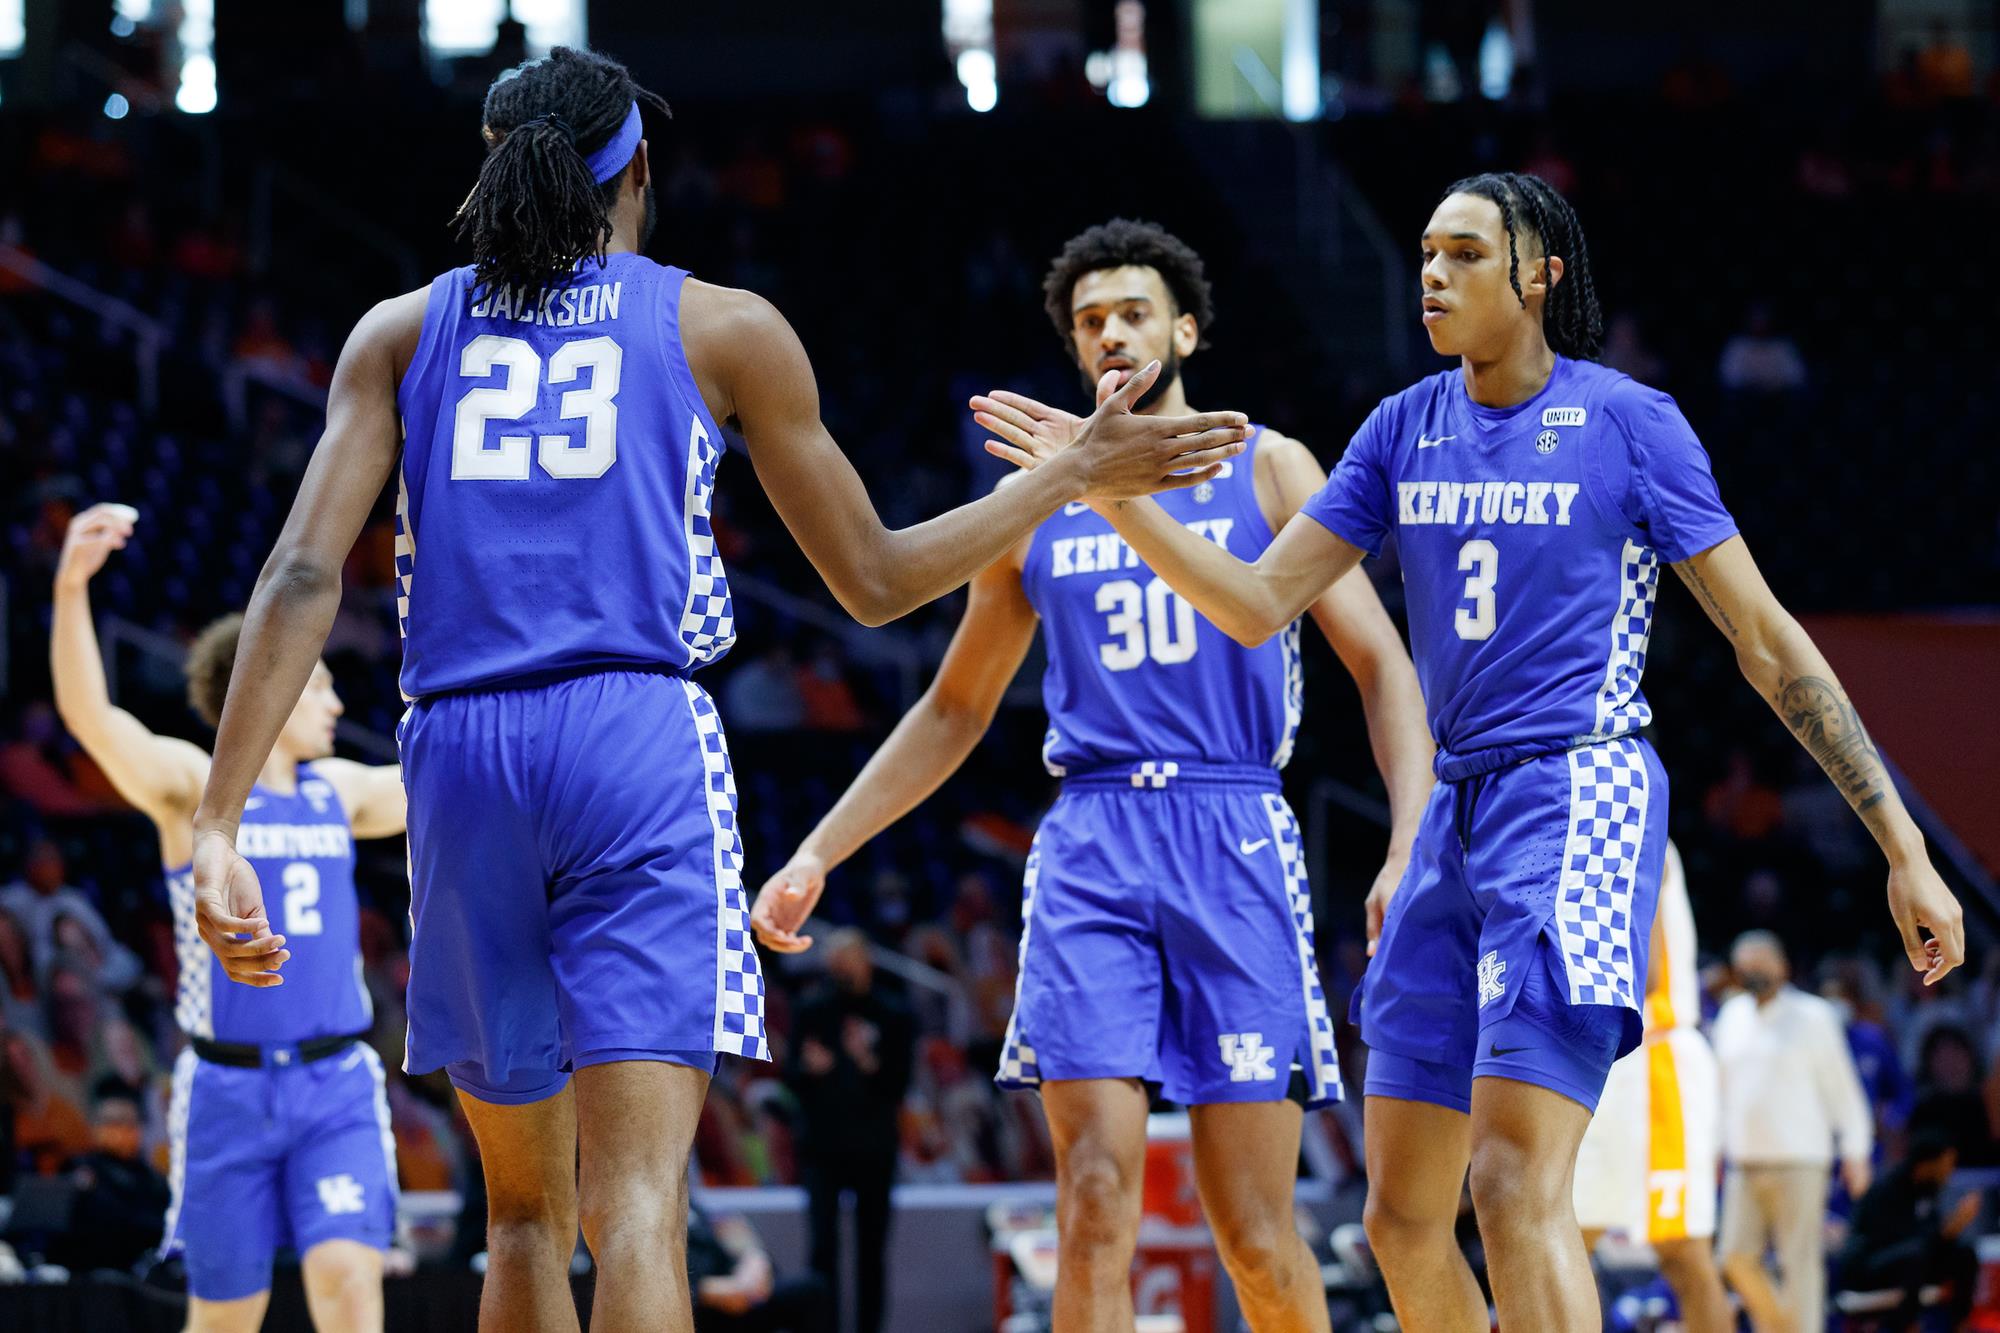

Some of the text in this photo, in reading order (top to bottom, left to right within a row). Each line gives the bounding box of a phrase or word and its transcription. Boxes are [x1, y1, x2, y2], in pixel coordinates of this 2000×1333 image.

[451, 334, 623, 481] 23
[1546, 411, 1580, 423] UNITY
[1537, 431, 1557, 452] SEC
[1397, 481, 1580, 526] KENTUCKY
[1455, 539, 1499, 641] 3
[1095, 576, 1198, 672] 30
[282, 862, 322, 936] 2
[1477, 950, 1506, 1008] UK
[1218, 1032, 1277, 1082] UK
